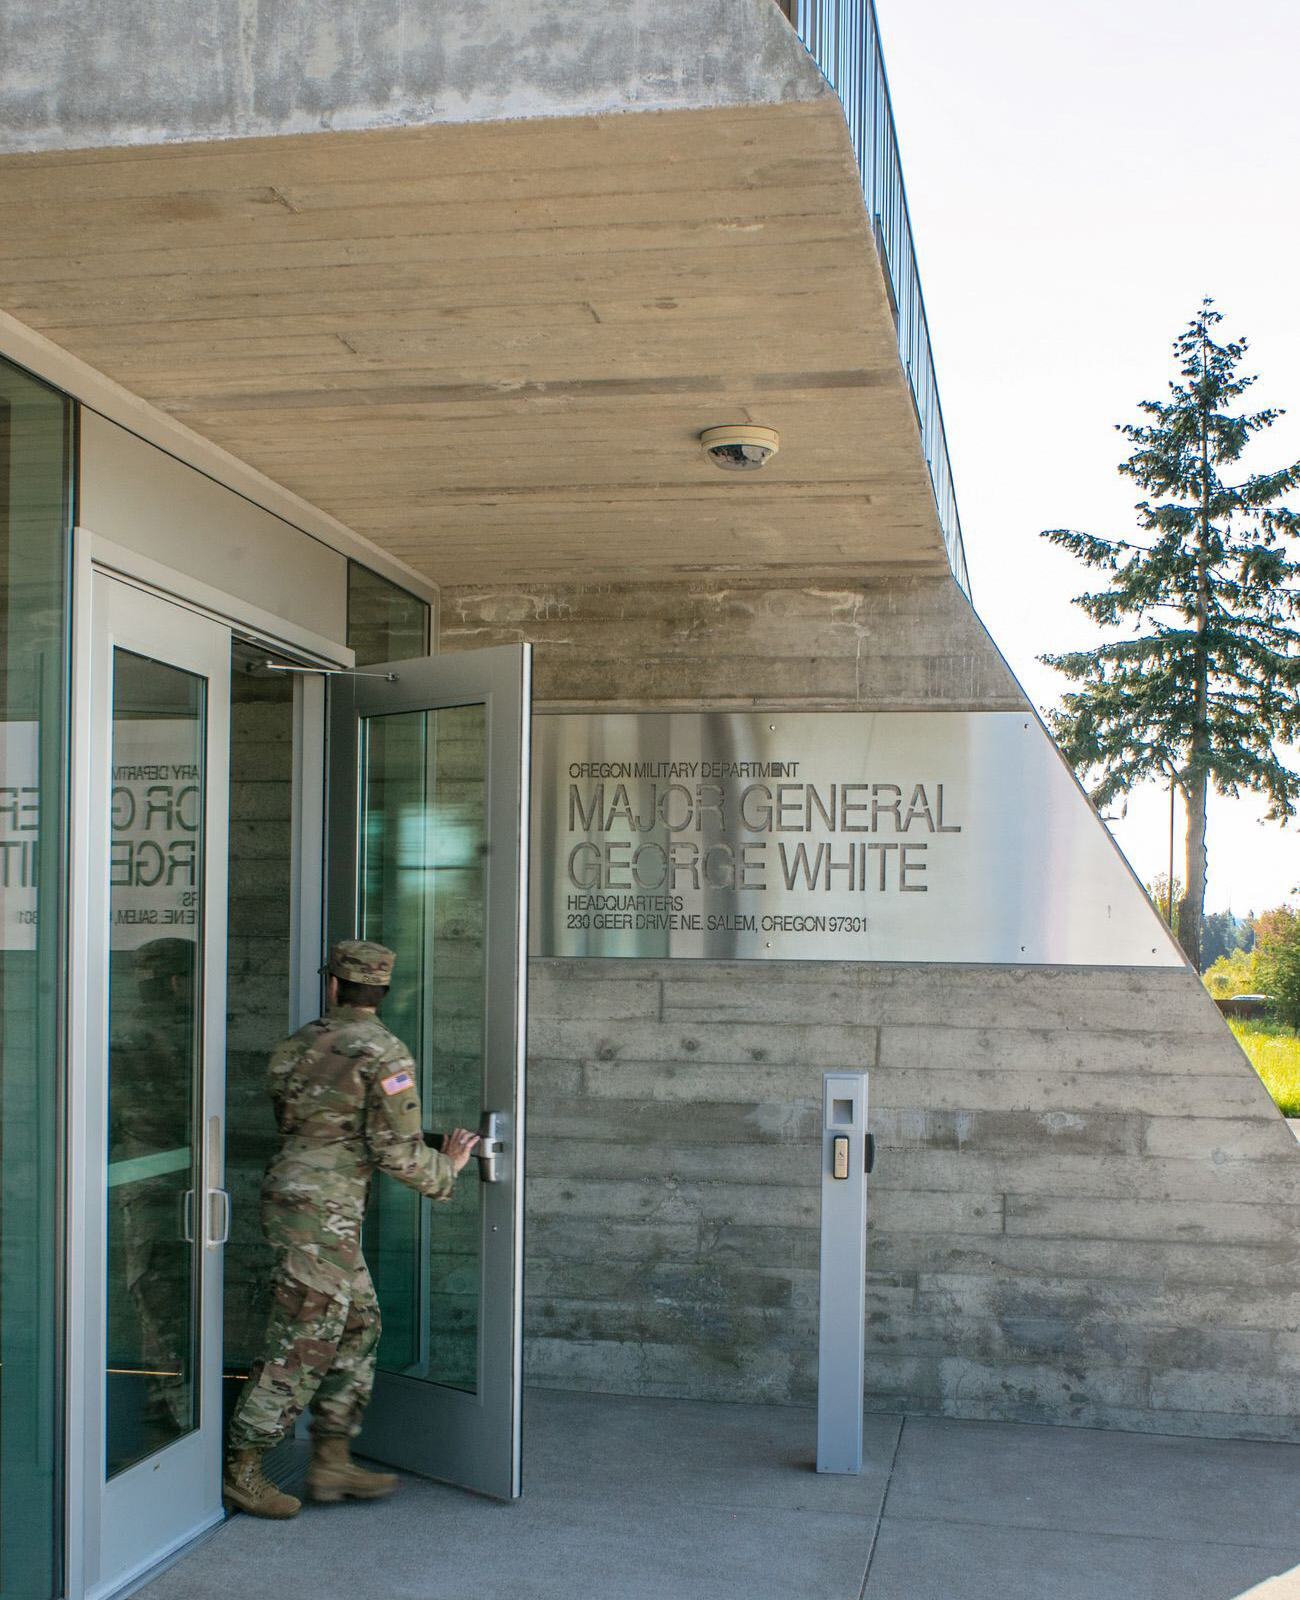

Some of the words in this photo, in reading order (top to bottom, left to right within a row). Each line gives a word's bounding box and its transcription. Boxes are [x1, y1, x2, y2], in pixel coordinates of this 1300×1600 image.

[568, 762, 631, 778] OREGON
[633, 762, 699, 778] MILITARY
[701, 762, 800, 778] DEPARTMENT
[568, 783, 727, 833] MAJOR
[741, 783, 962, 833] GENERAL
[567, 841, 767, 891] GEORGE
[778, 842, 929, 892] WHITE
[567, 895, 684, 912] HEADQUARTERS
[567, 914, 591, 929] 230
[593, 914, 633, 930] GEER
[636, 914, 678, 930] DRIVE
[681, 914, 704, 930] NE.
[707, 915, 758, 933] SALEM,
[761, 915, 826, 932] OREGON
[828, 916, 868, 933] 97301
